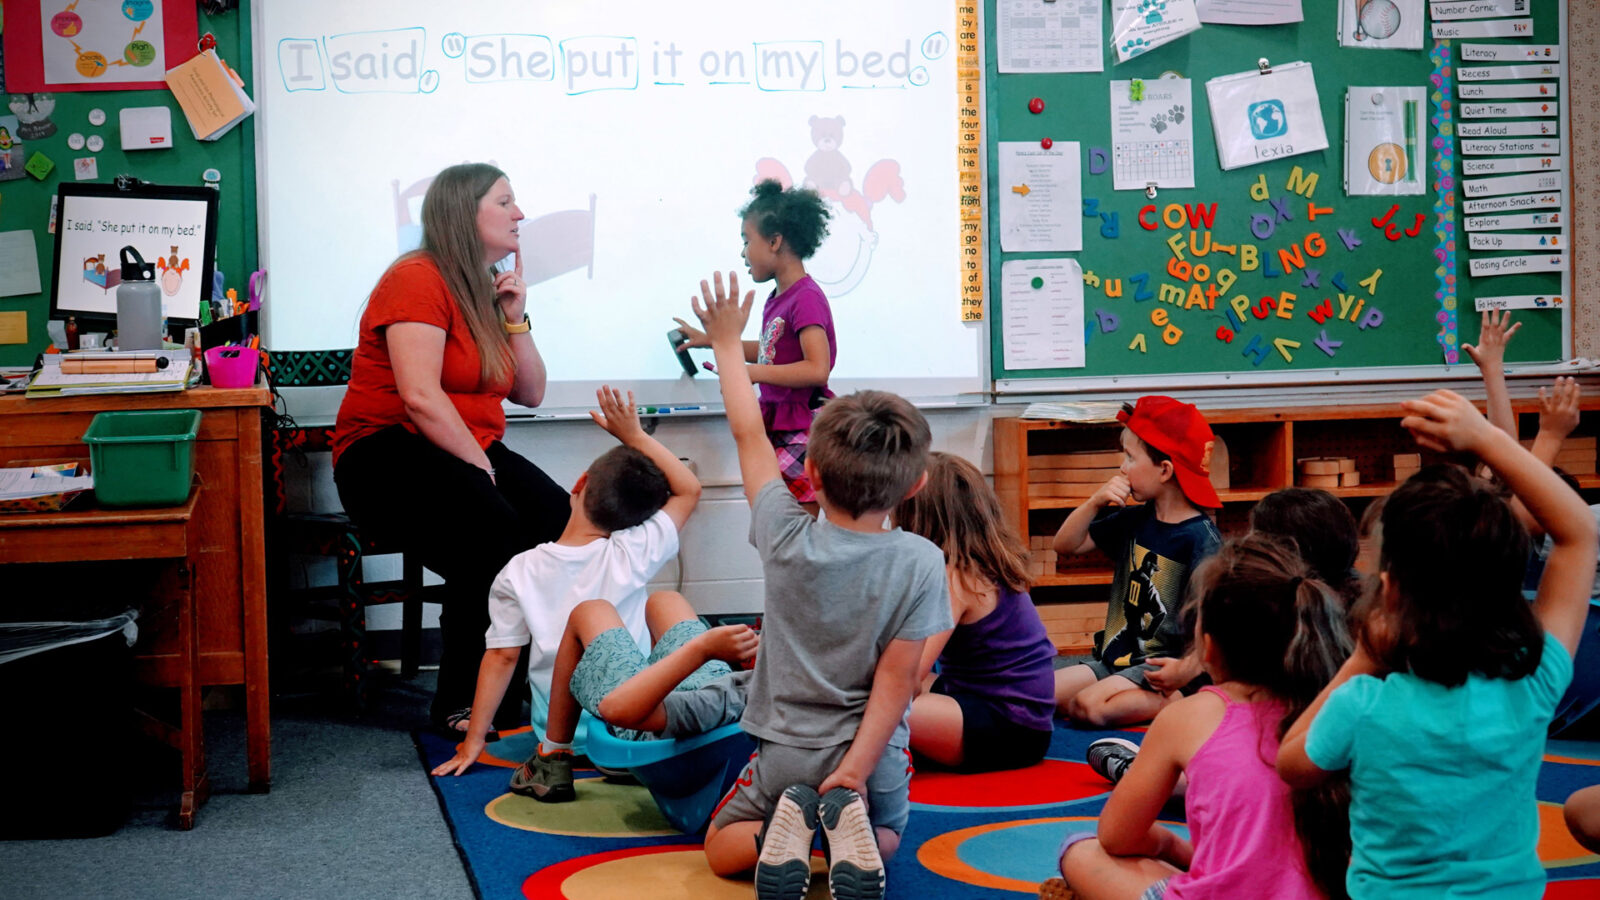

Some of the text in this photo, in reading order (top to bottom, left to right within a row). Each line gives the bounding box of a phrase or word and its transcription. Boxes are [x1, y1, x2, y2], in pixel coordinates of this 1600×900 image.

[1435, 4, 1498, 15] Number Corner
[962, 18, 972, 27] by
[1436, 28, 1460, 36] Music
[960, 43, 976, 51] has
[1465, 48, 1497, 59] Literacy
[288, 44, 313, 82] I
[567, 42, 635, 90] put
[653, 40, 683, 77] it
[700, 50, 745, 78] on
[762, 50, 819, 89] my
[1461, 69, 1490, 77] Recess
[965, 83, 972, 91] is
[1462, 87, 1484, 96] Lunch
[961, 107, 976, 116] the
[1464, 106, 1507, 115] Quiet Time
[961, 120, 978, 128] four
[1462, 125, 1507, 135] Read Aloud
[959, 146, 977, 154] have
[1254, 143, 1294, 159] lexia
[1465, 142, 1534, 152] Literacy Stations
[963, 159, 975, 167] he
[1467, 162, 1494, 171] Science
[963, 184, 978, 192] we
[1468, 185, 1488, 193] Math
[1468, 197, 1536, 210] Afternoon Snack
[964, 222, 978, 231] my
[1469, 218, 1500, 228] Explore
[66, 219, 73, 230] I
[120, 223, 136, 236] put
[138, 223, 146, 233] it
[148, 225, 158, 234] on
[161, 226, 175, 238] my
[965, 235, 977, 244] go
[1473, 236, 1503, 246] Pack Up
[965, 247, 977, 255] no
[966, 260, 976, 269] to
[1474, 258, 1527, 271] Closing Circle
[968, 273, 978, 282] of
[964, 285, 981, 295] you
[962, 298, 982, 307] they
[1477, 299, 1507, 309] Go Home
[965, 311, 981, 320] she
